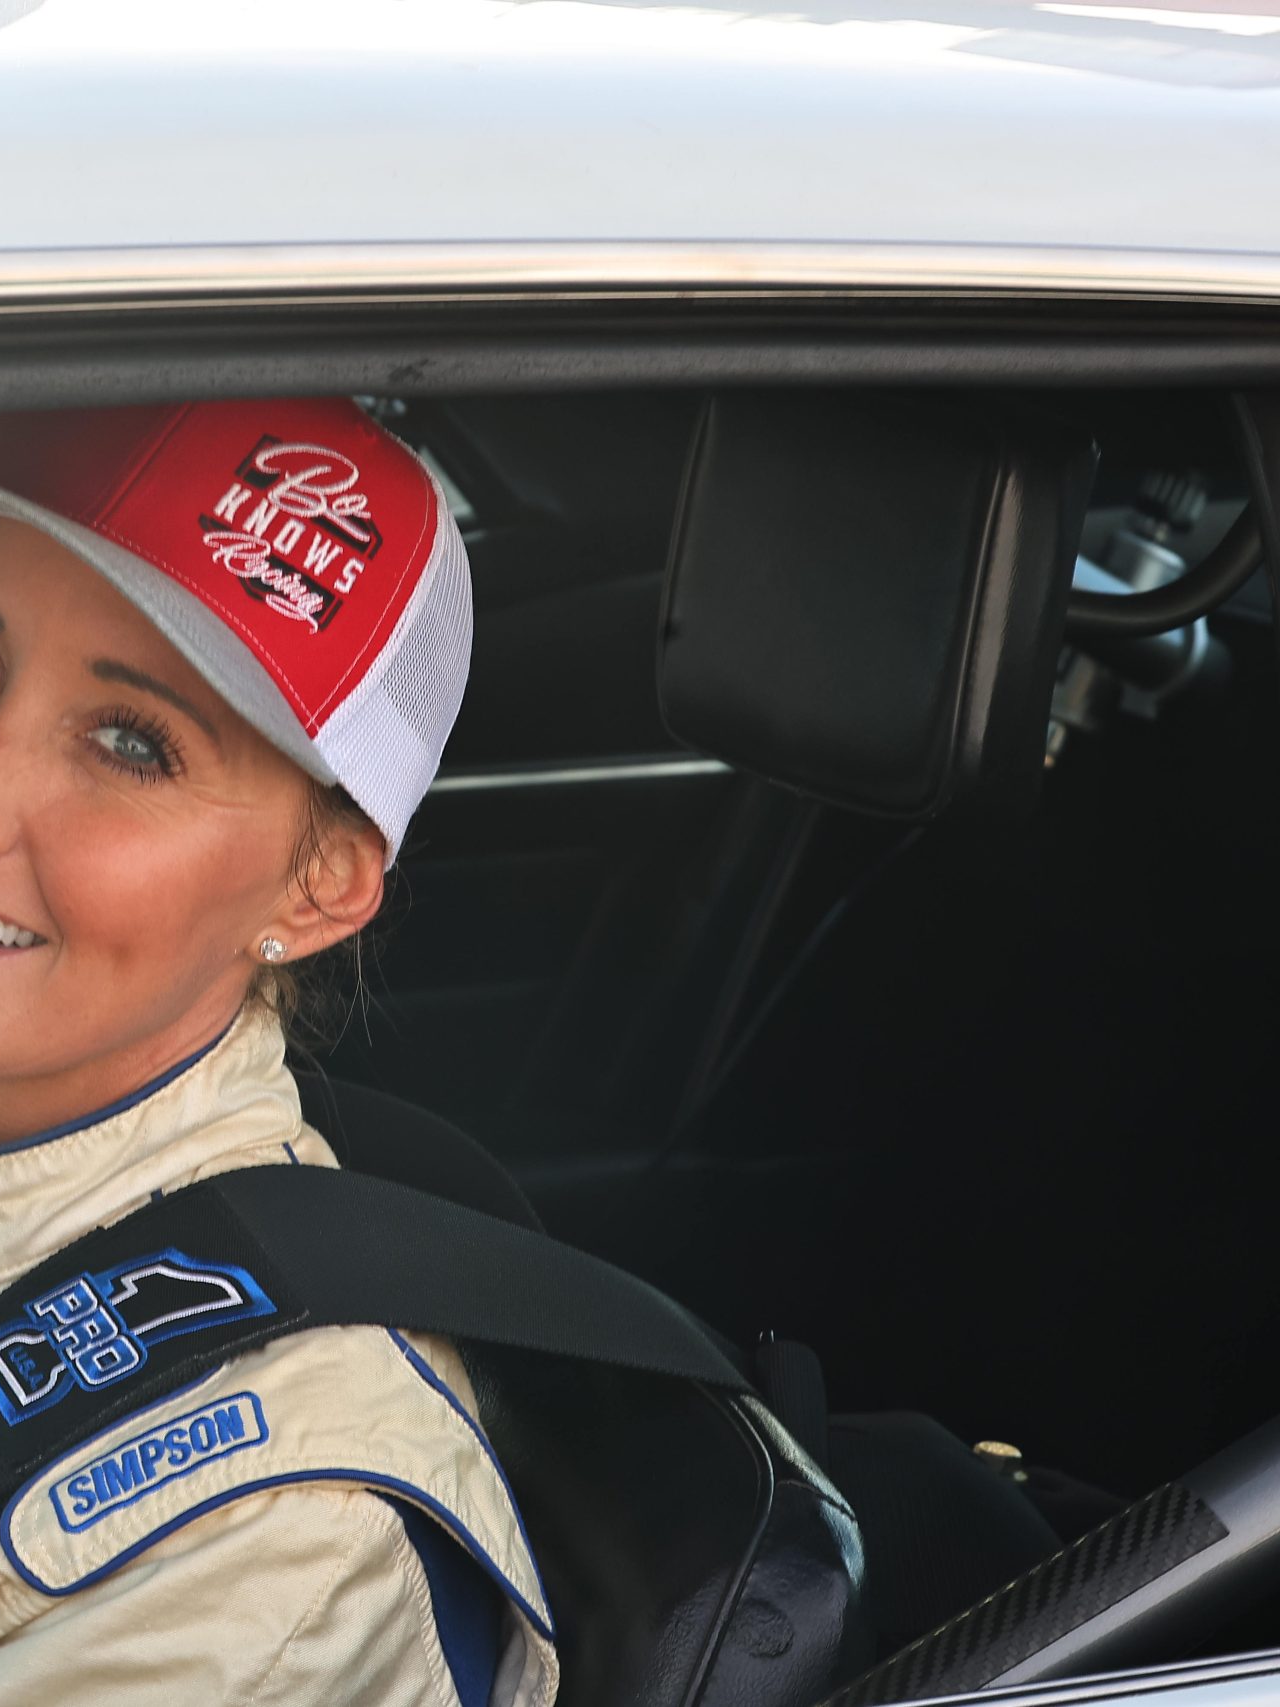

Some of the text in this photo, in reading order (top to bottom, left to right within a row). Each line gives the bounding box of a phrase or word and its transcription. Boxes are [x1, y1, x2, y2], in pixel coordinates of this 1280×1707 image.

[213, 483, 365, 593] KNOWS
[255, 444, 371, 542] Bo
[203, 531, 324, 634] Racing
[32, 1276, 142, 1386] PRO
[67, 1404, 246, 1515] SIMPSON
